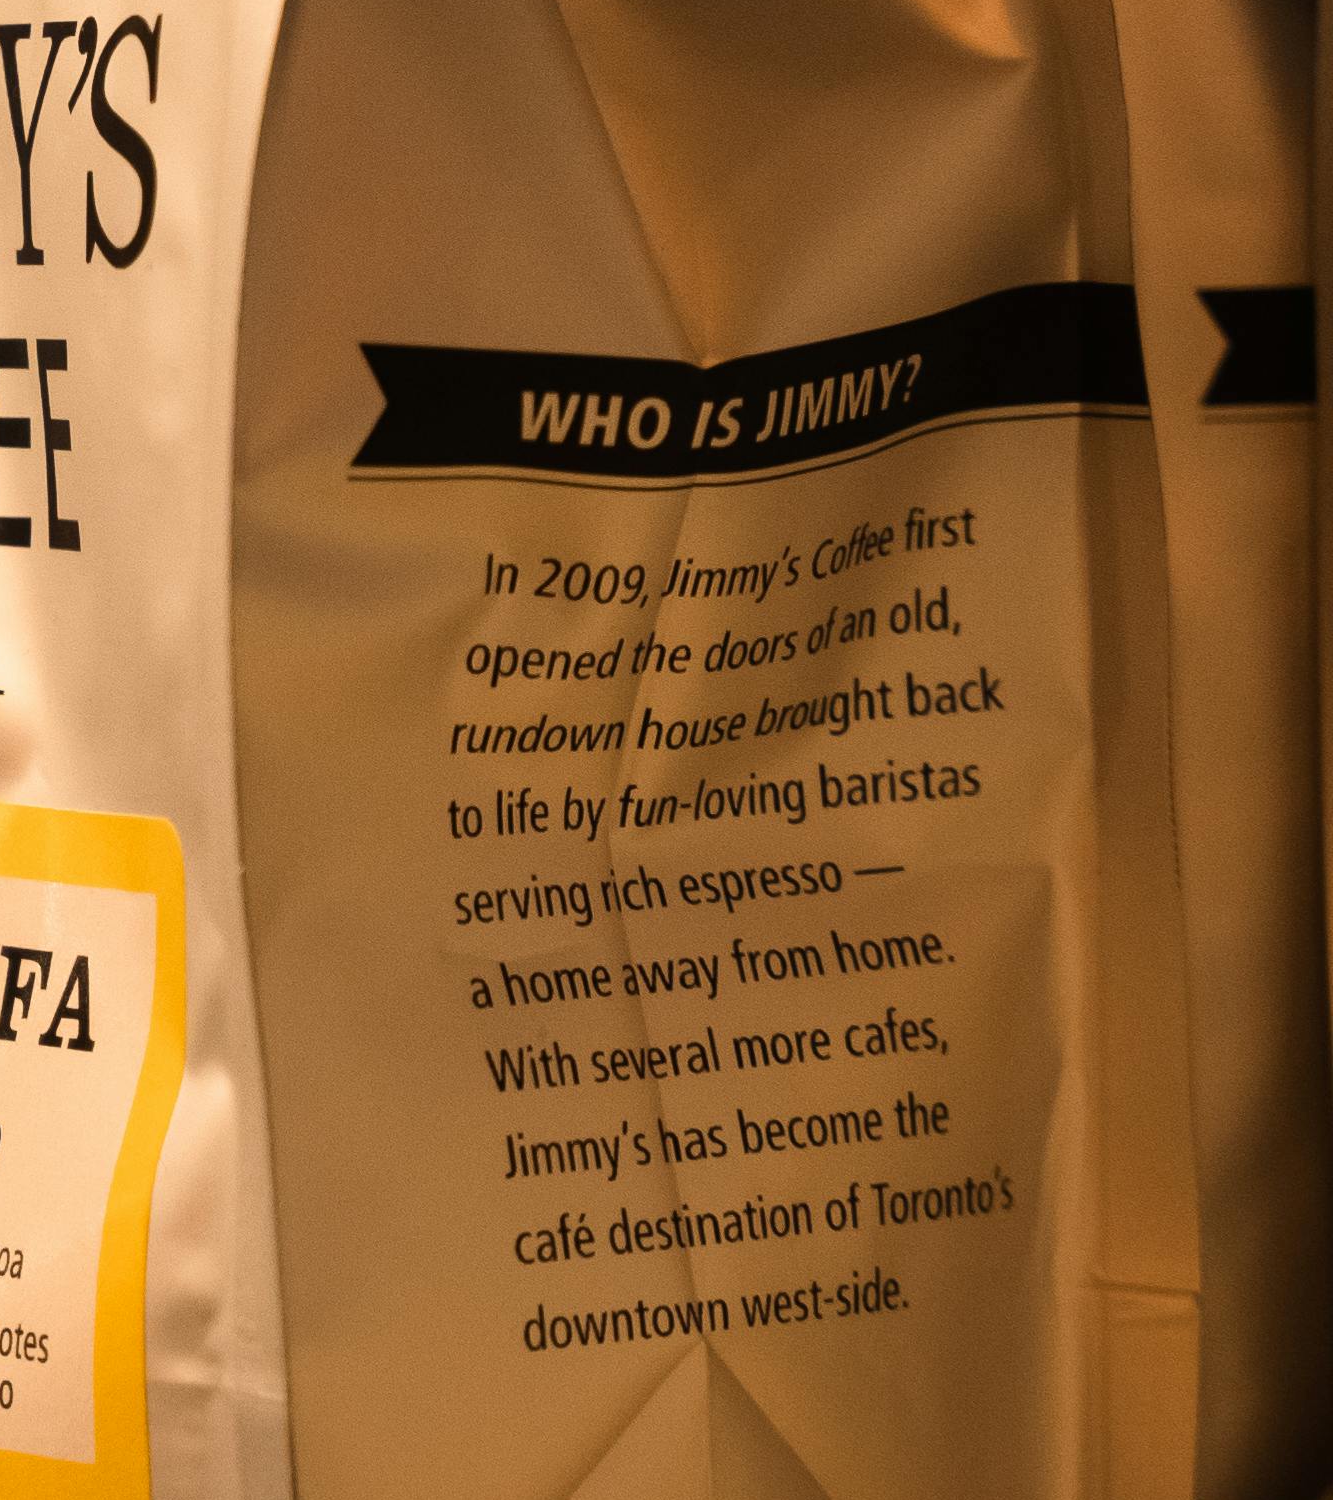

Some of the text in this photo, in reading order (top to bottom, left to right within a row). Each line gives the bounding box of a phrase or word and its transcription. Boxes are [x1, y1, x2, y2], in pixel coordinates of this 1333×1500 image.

[519, 354, 923, 451] WHO IS JIMMY?
[484, 507, 977, 608] In 2009, Jimmy's Coffee first
[466, 586, 962, 688] opened the doors of an old,
[450, 666, 1005, 755] rundown house brought back
[448, 760, 982, 842] to life by fun-loving baristas
[455, 875, 593, 927] serving
[603, 866, 667, 913] rich
[679, 861, 843, 913] espresso
[471, 930, 956, 1010] a home away from home.
[485, 1006, 950, 1092] With several more cafes,
[505, 1091, 951, 1181] Jimmy's has become the
[514, 1164, 1016, 1265] café destination of Toronto's
[523, 1265, 910, 1352] downtown west-side.
